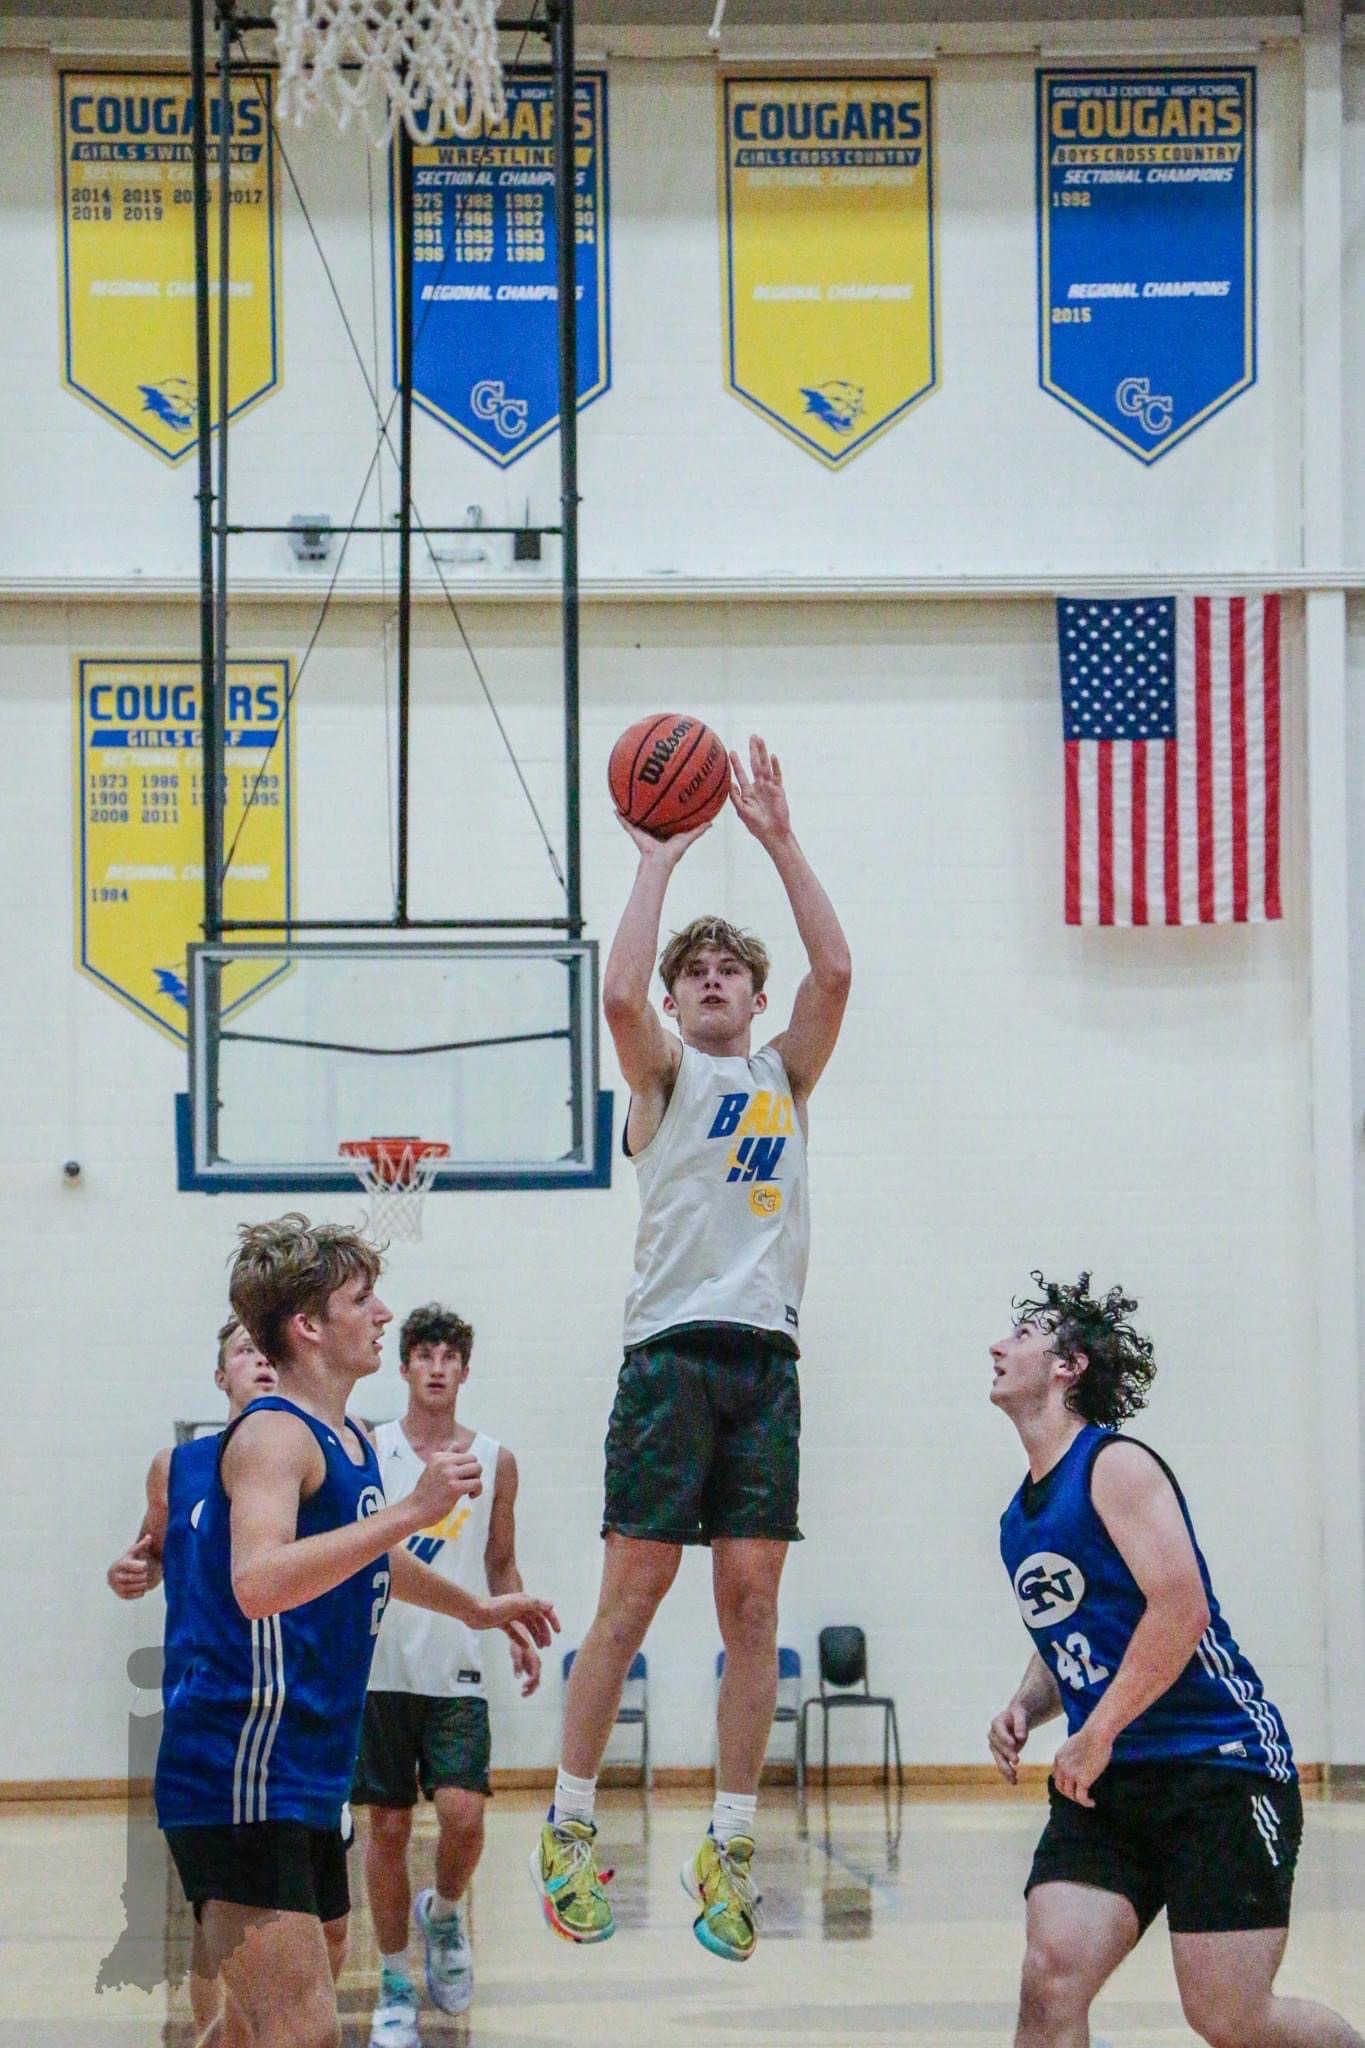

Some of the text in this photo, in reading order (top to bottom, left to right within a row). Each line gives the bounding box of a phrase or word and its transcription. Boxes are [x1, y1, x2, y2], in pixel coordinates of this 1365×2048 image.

[734, 102, 922, 140] COUGARS
[1052, 99, 1242, 138] COUGARS
[79, 145, 137, 159] GIRLS
[740, 150, 916, 164] GIRLS CROSS COUNTRY
[1057, 146, 1237, 161] BOYS CROSS COUNTRY
[416, 171, 494, 186] SECTIONAL
[1063, 167, 1234, 184] SECTIONAL CHAMPIONS
[72, 188, 110, 203] 2014
[122, 188, 162, 204] 2015
[228, 190, 262, 204] 017
[413, 193, 443, 209] 975
[413, 211, 443, 226] 985
[413, 229, 442, 244] 991
[421, 285, 493, 301] REGIONAL
[1068, 281, 1231, 299] REGIONAL CHAMPIONS
[1051, 308, 1092, 323] 2015
[90, 684, 279, 721] COUGRS
[639, 720, 694, 785] Wilson
[726, 1136, 787, 1182] IN
[370, 1570, 390, 1636] 2
[1051, 1631, 1110, 1691] 42
